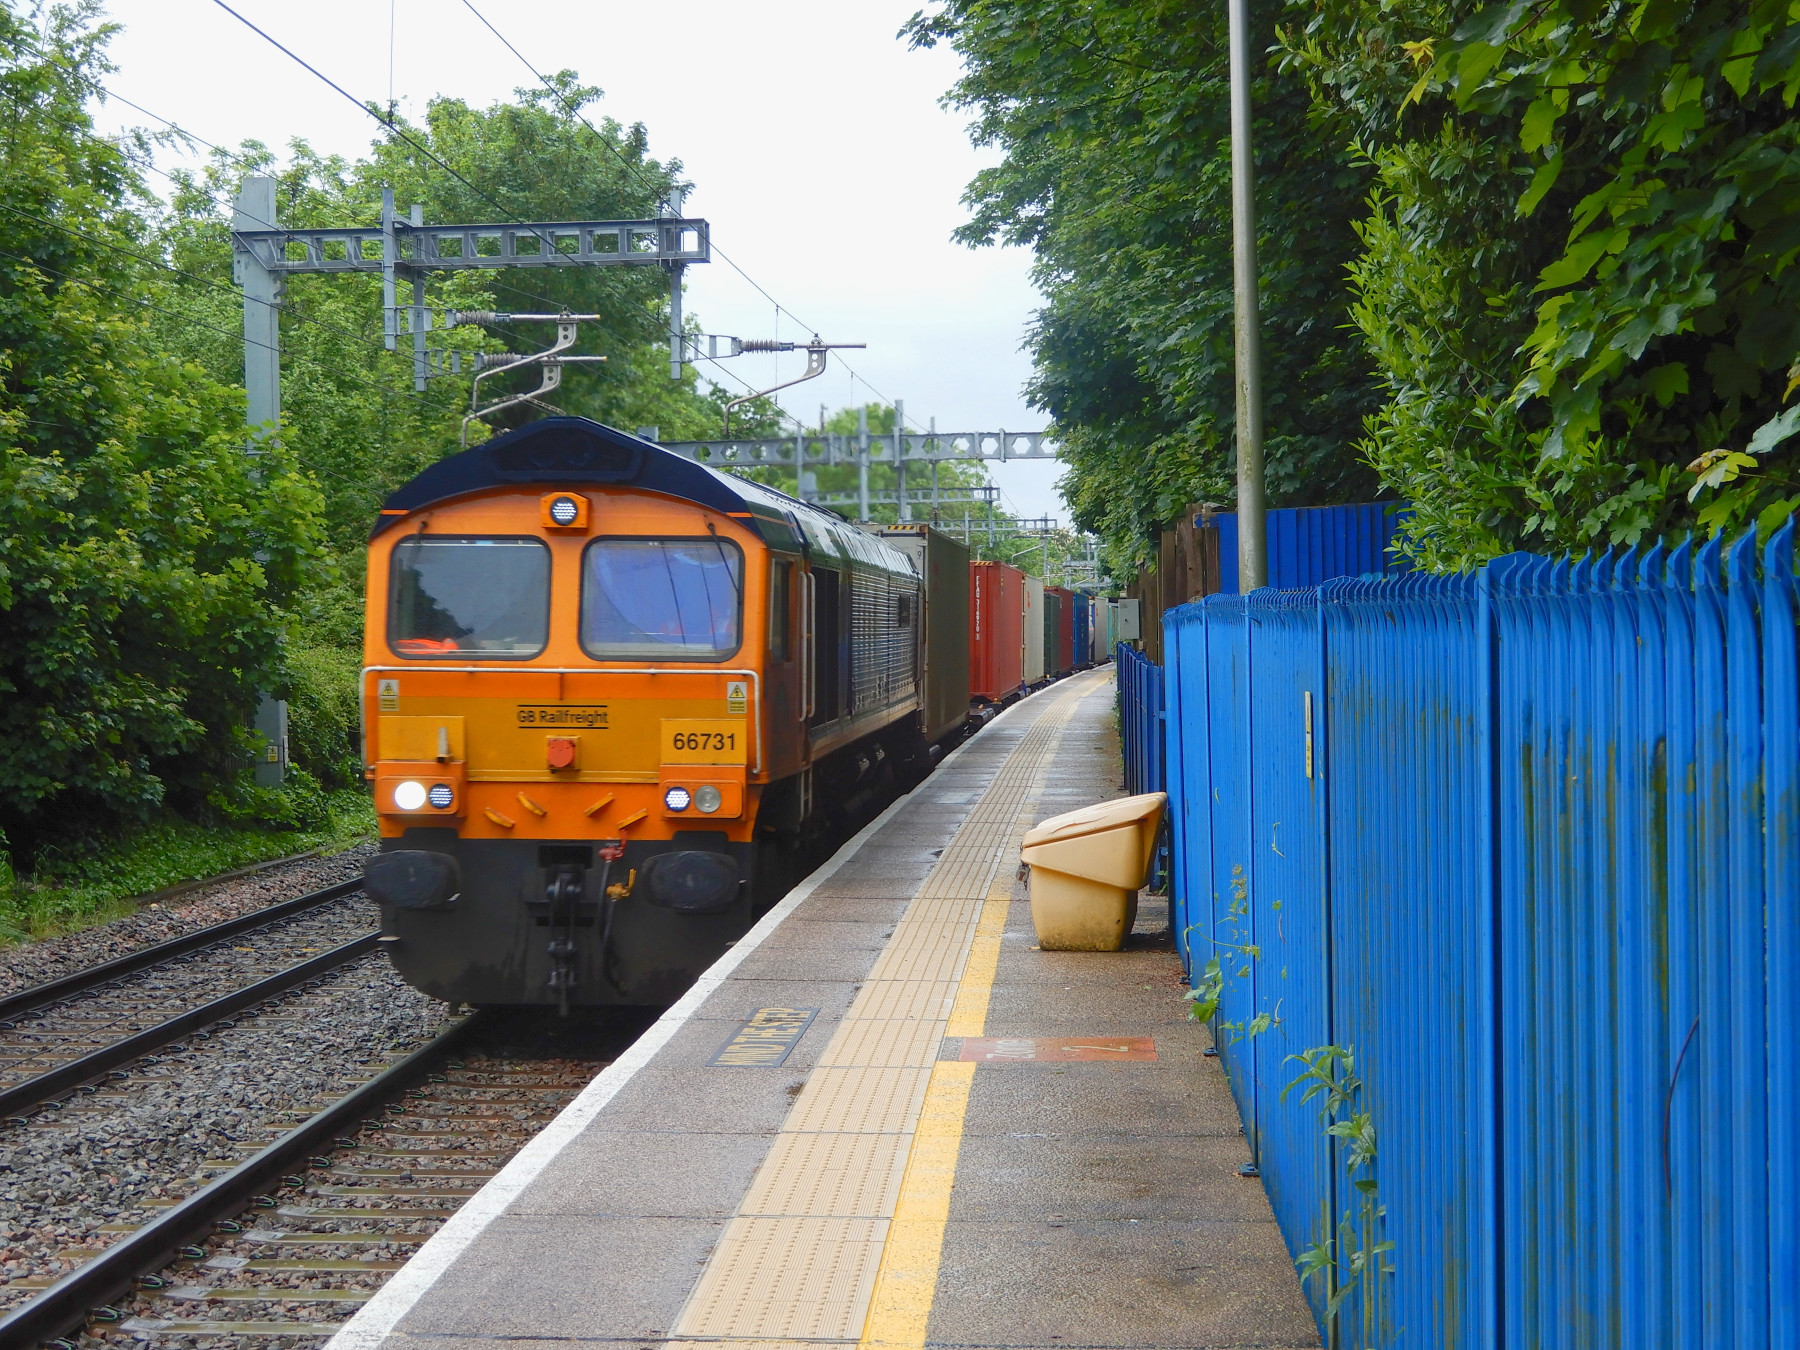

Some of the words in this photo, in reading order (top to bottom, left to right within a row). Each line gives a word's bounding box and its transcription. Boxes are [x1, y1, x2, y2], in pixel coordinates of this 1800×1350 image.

[517, 710, 536, 723] GB
[538, 709, 609, 727] Railfreight
[673, 732, 737, 751] 66731
[748, 1007, 812, 1027] STEP
[733, 1027, 799, 1043] THE
[714, 1043, 786, 1066] MIND
